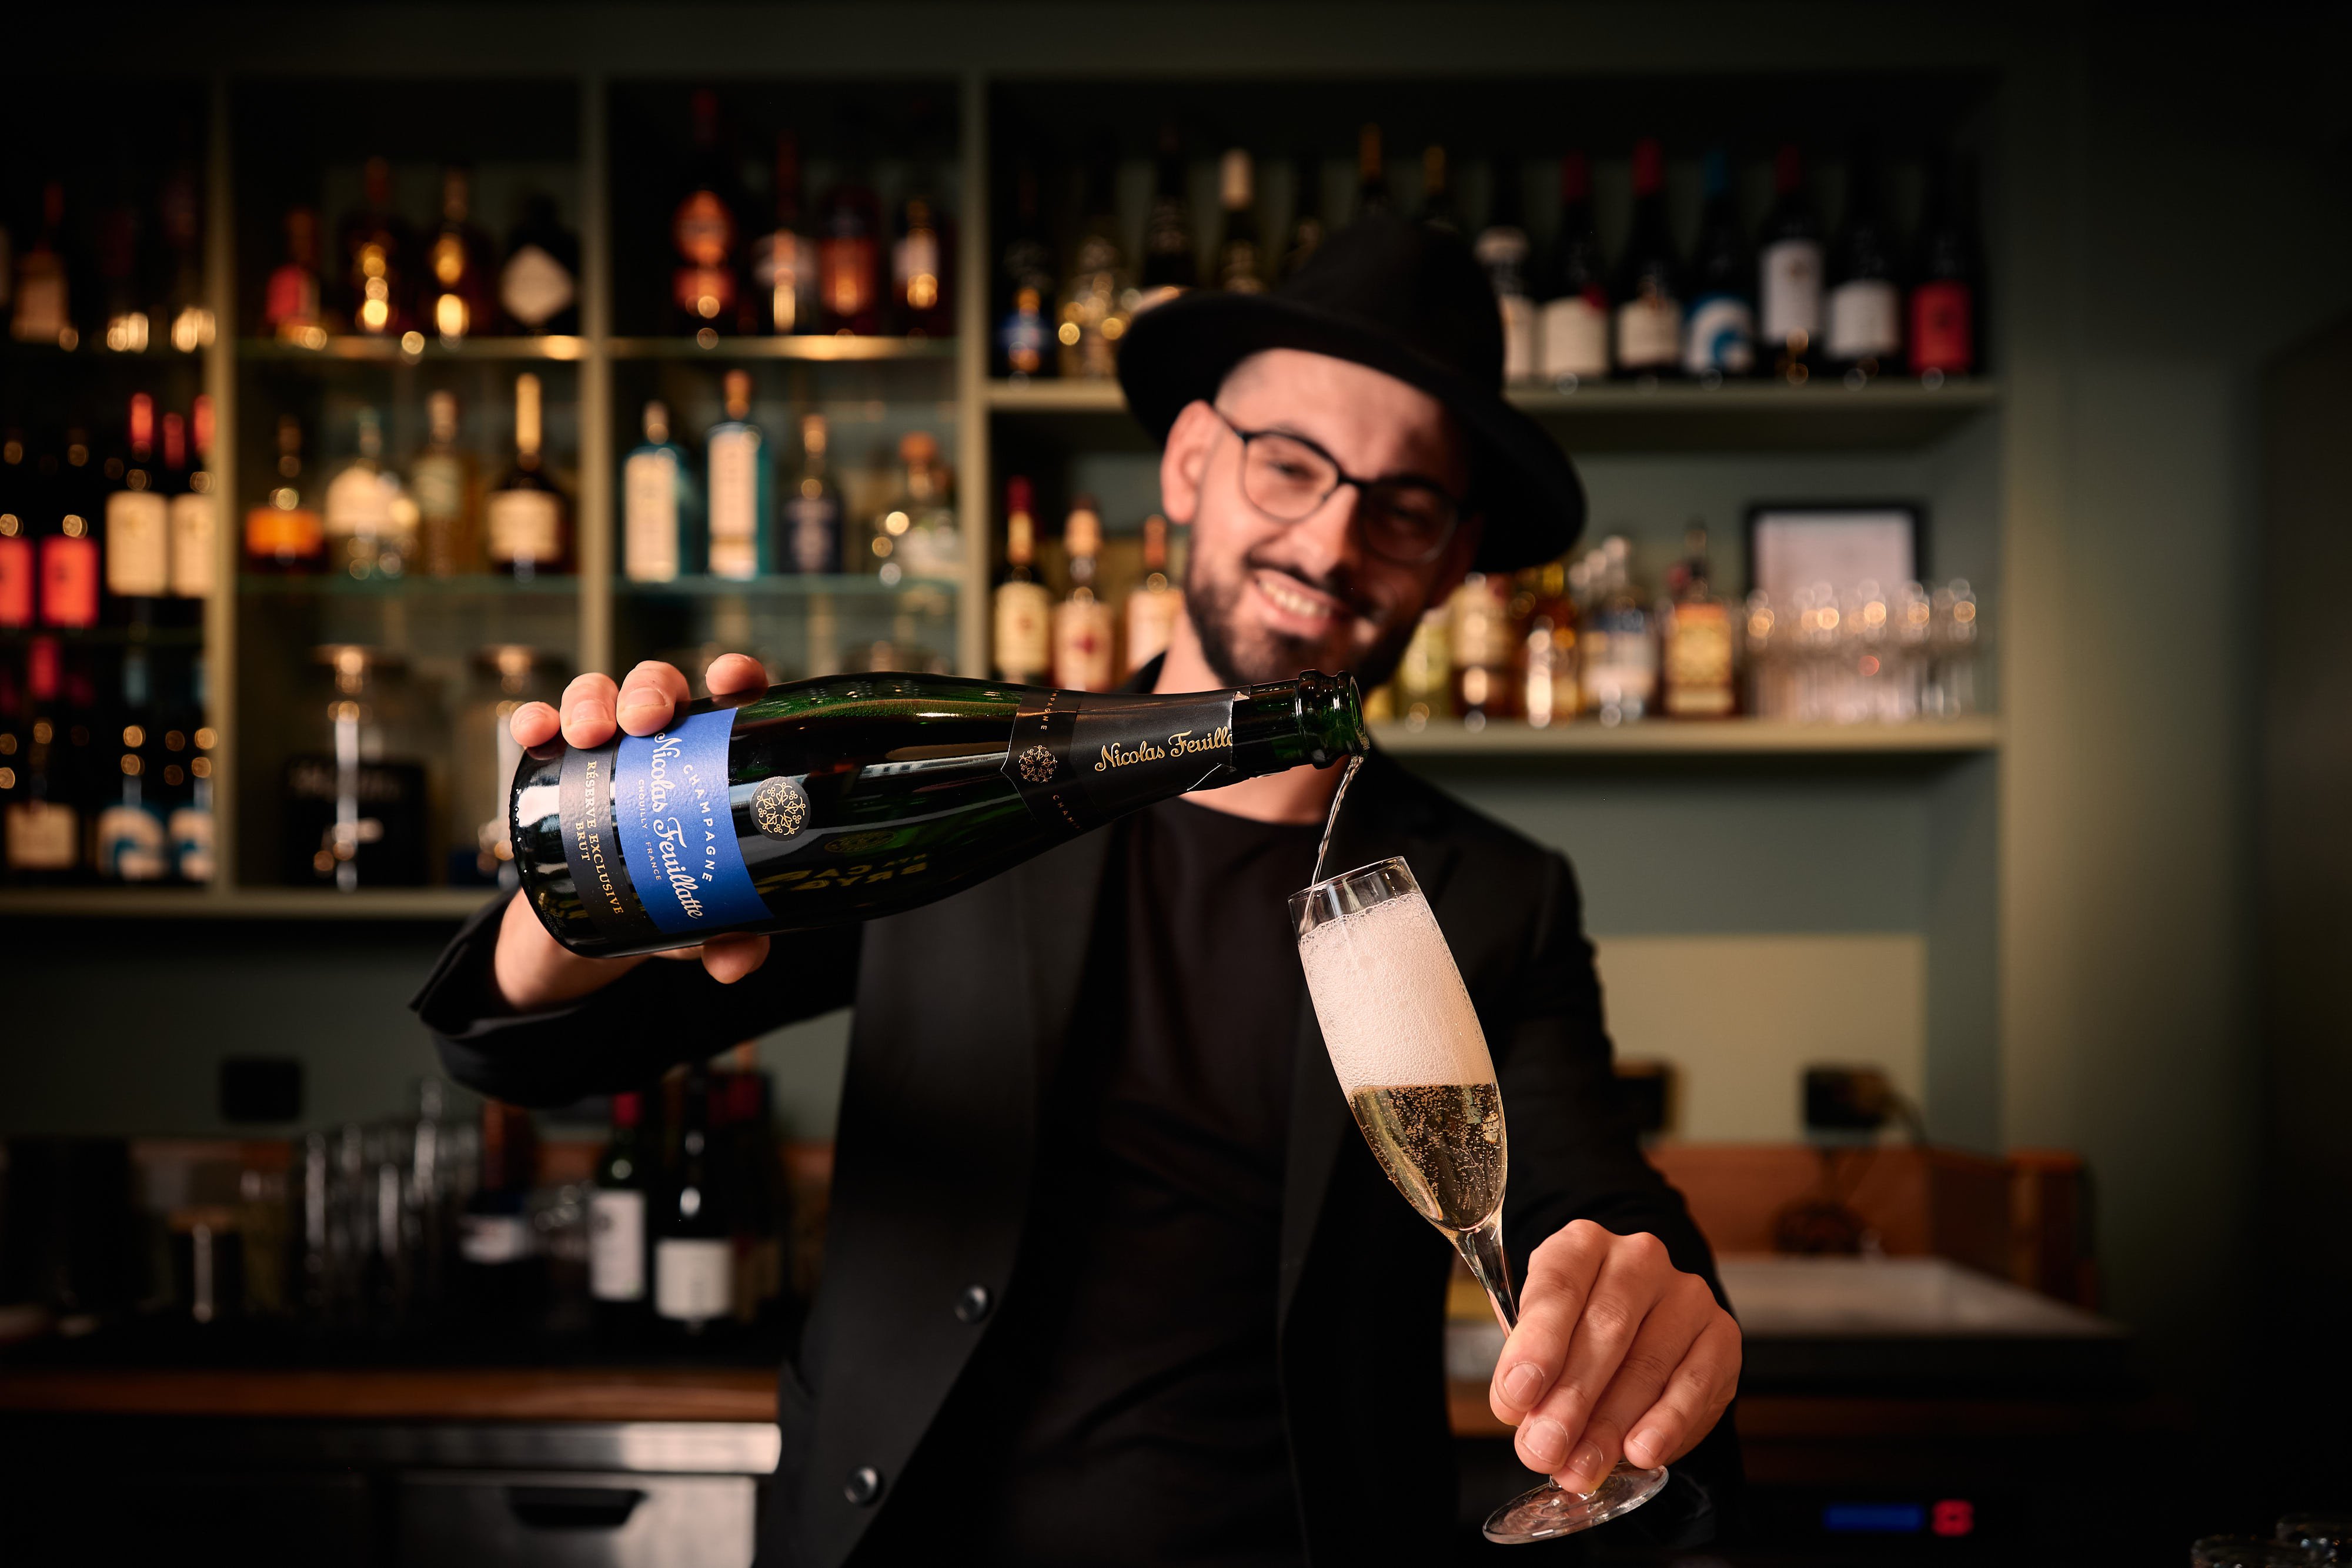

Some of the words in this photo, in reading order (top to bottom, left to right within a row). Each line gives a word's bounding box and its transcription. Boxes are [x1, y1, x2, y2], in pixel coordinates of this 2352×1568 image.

[585, 761, 598, 828] RÉSERVE
[650, 732, 682, 813] Nicolas
[1094, 740, 1165, 771] Nicolas
[575, 821, 590, 861] BRUT
[638, 779, 647, 829] CHOUILLY
[645, 842, 662, 881] FRANCE
[683, 764, 716, 882] CHAMPAGNE
[589, 833, 623, 914] EXCLUSIVE
[653, 817, 703, 919] Feuillatte
